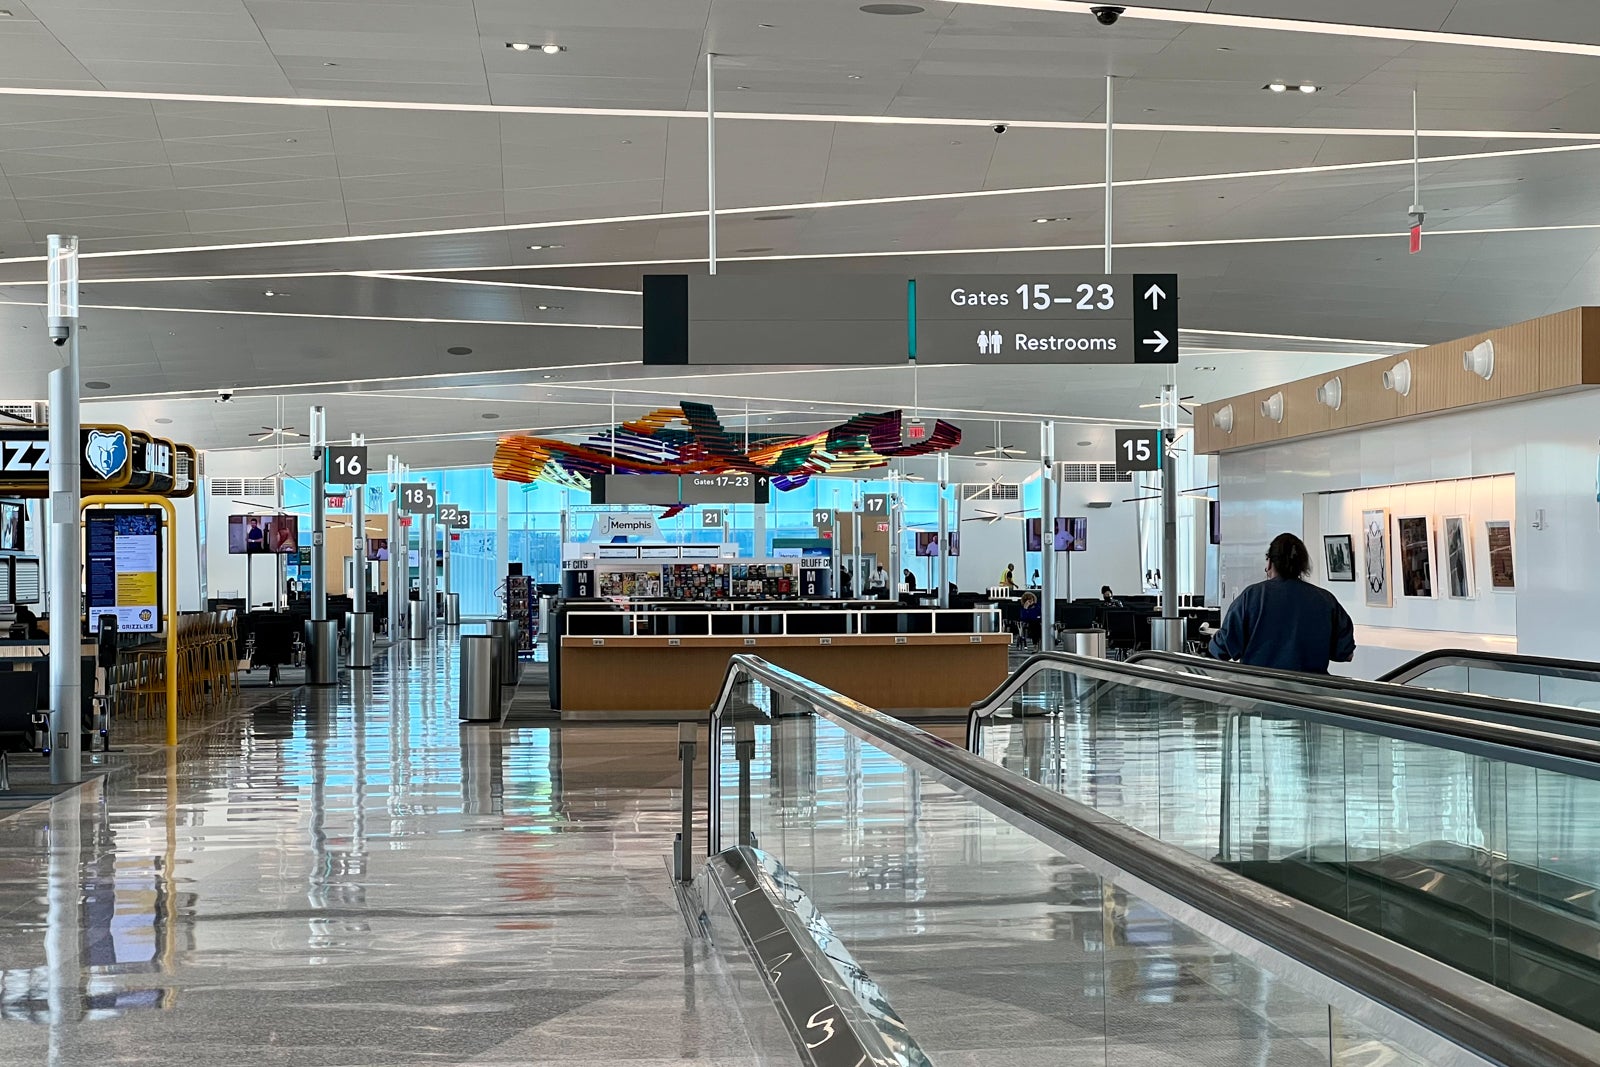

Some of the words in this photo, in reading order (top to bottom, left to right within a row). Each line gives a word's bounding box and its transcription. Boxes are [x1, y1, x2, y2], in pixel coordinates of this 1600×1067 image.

[950, 288, 1009, 306] Gates
[1015, 283, 1115, 310] 15–23
[1015, 333, 1117, 351] Restrooms
[1122, 439, 1151, 461] 15
[335, 455, 362, 475] 16
[693, 478, 714, 486] Gates
[715, 476, 749, 487] 17–23
[405, 489, 424, 503] 18
[867, 498, 883, 512] 17
[440, 509, 457, 520] 22
[704, 513, 718, 523] 21
[815, 512, 829, 523] 19
[611, 520, 652, 530] Memphis
[572, 560, 588, 569] CITY
[801, 558, 822, 568] BLUFF
